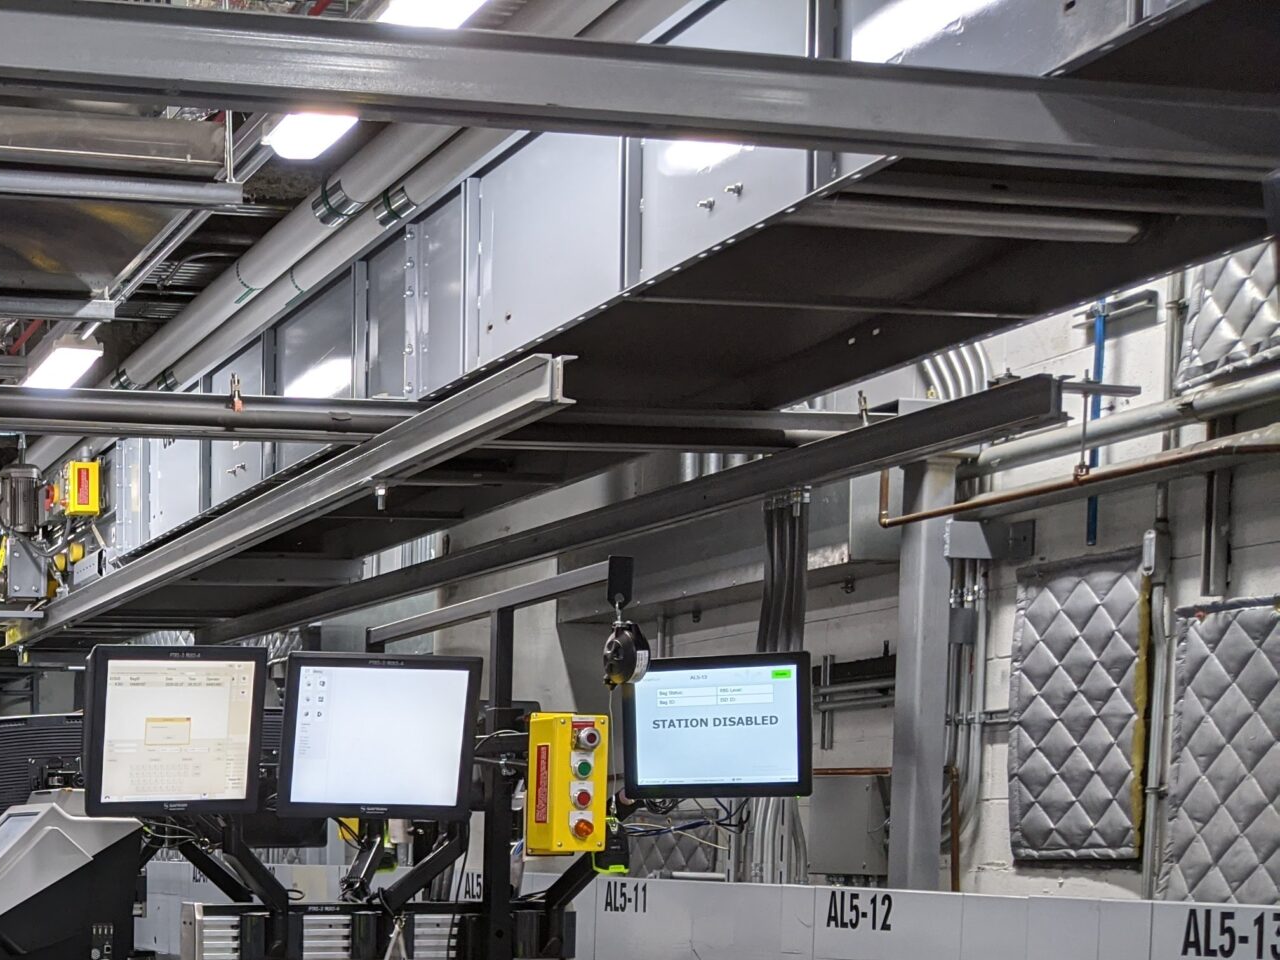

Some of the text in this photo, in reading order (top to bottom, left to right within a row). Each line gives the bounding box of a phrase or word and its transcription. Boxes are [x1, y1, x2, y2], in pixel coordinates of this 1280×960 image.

[652, 715, 779, 730] STATION DISABLED
[604, 880, 648, 913] AL5-11
[826, 890, 893, 932] AL5-12
